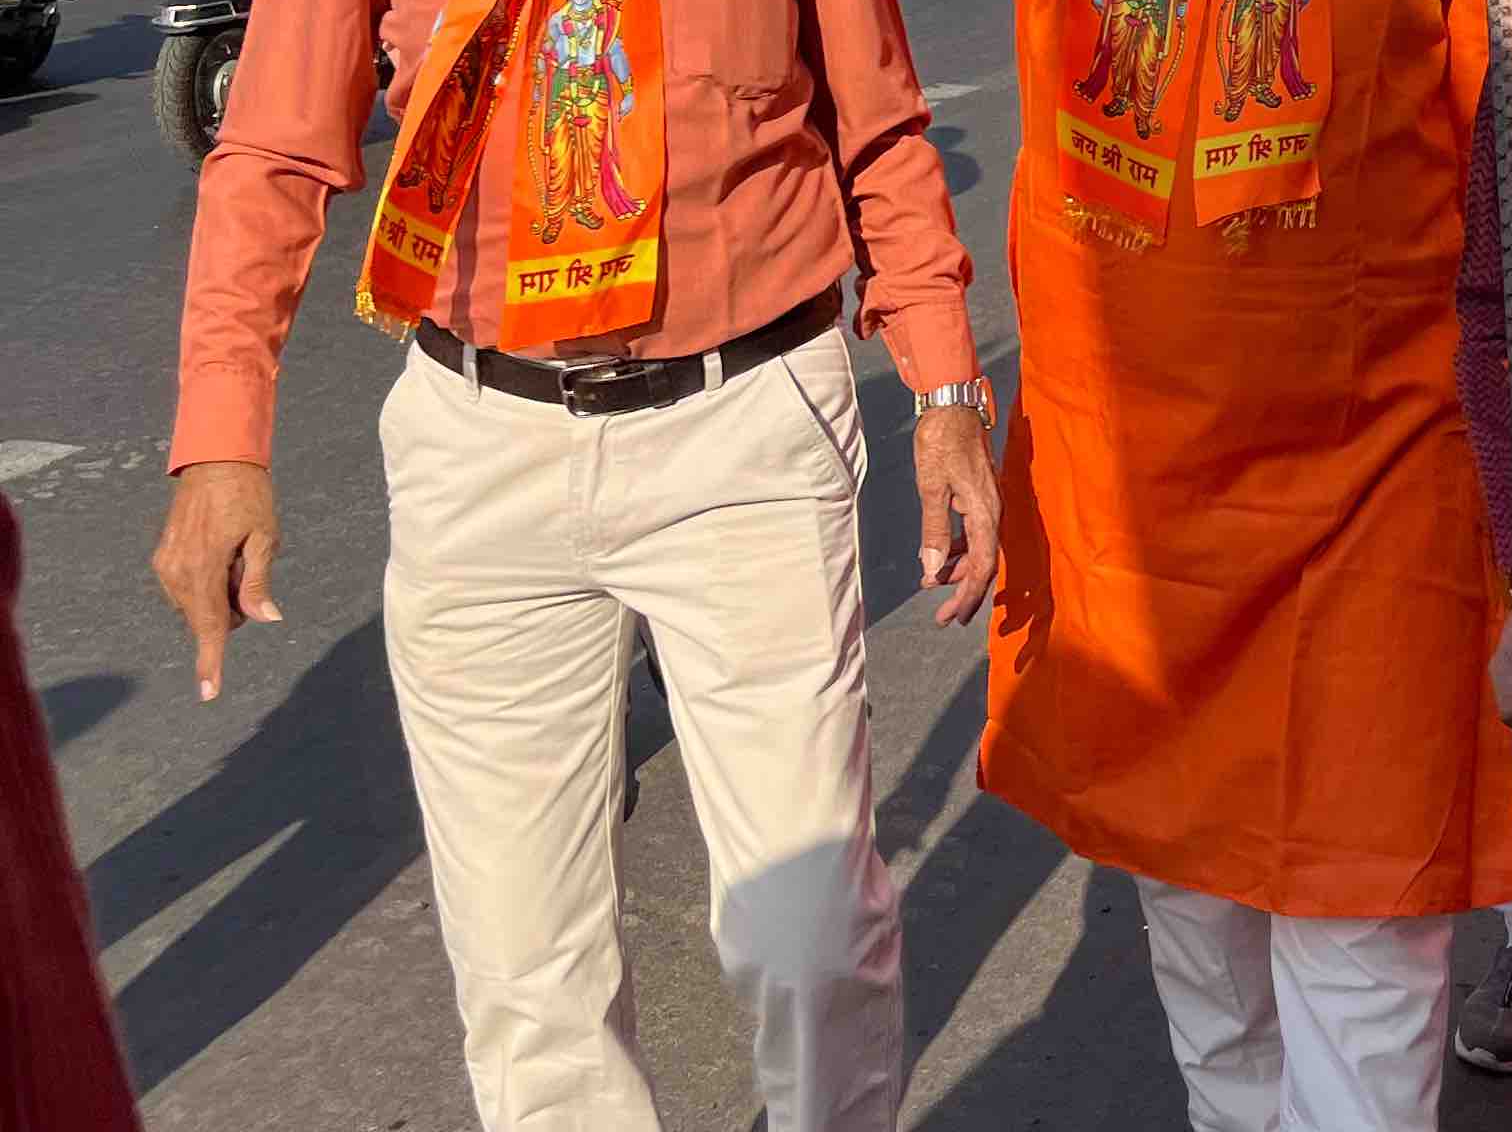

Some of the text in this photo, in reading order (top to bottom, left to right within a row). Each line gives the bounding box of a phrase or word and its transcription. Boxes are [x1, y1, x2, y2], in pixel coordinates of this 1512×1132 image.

[1071, 129, 1159, 188] जय श्री राम
